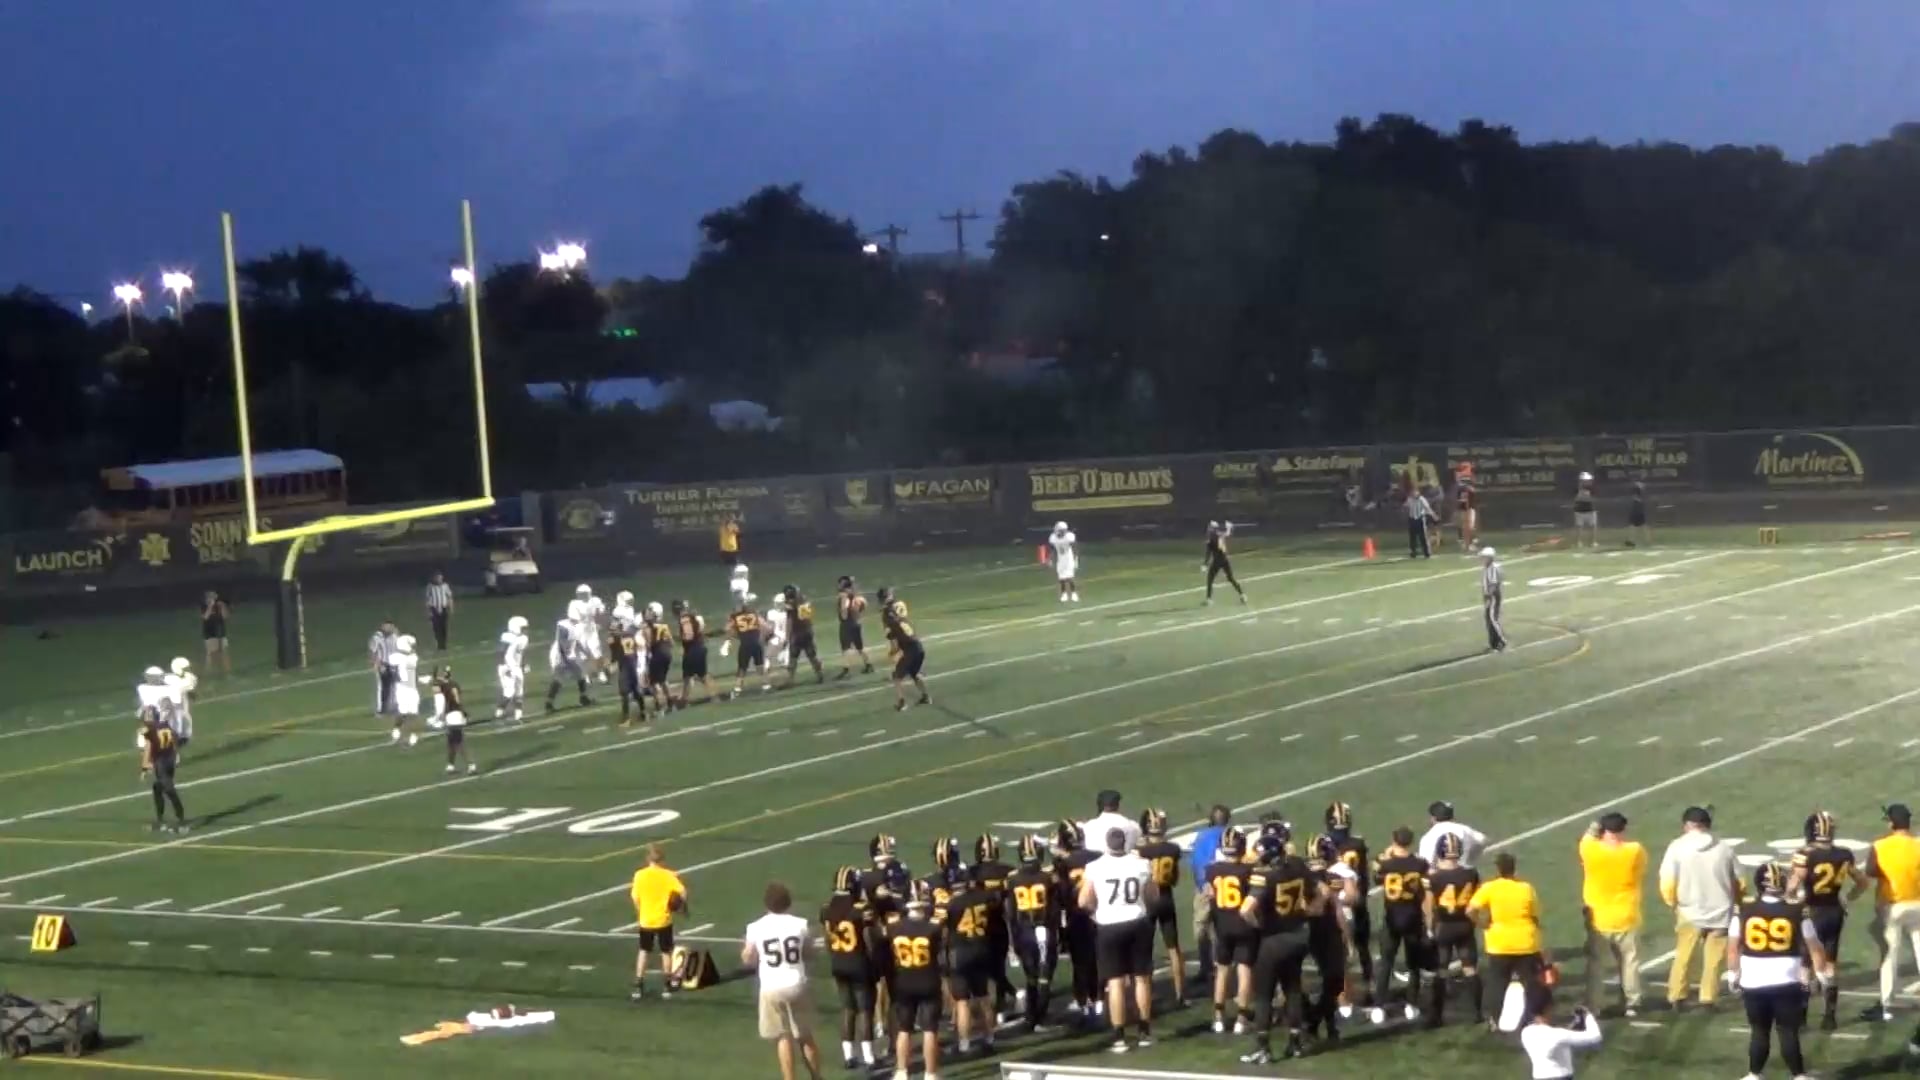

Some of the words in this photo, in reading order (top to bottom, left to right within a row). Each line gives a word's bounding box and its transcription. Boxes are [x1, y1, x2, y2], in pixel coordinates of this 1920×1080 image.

[1753, 448, 1850, 475] Martinez
[624, 488, 698, 505] TURNER
[915, 478, 991, 496] FAGAN
[1031, 474, 1080, 496] BEEF
[15, 549, 104, 573] LAUNCH
[1105, 877, 1140, 905] 70
[1213, 875, 1241, 909] 16
[1813, 862, 1851, 894] 24
[1275, 879, 1306, 915] 57
[1438, 884, 1474, 914] 44
[36, 918, 57, 947] 10
[956, 904, 988, 938] 45
[1745, 917, 1792, 951] 69
[763, 936, 801, 967] 56
[893, 936, 930, 967] 66
